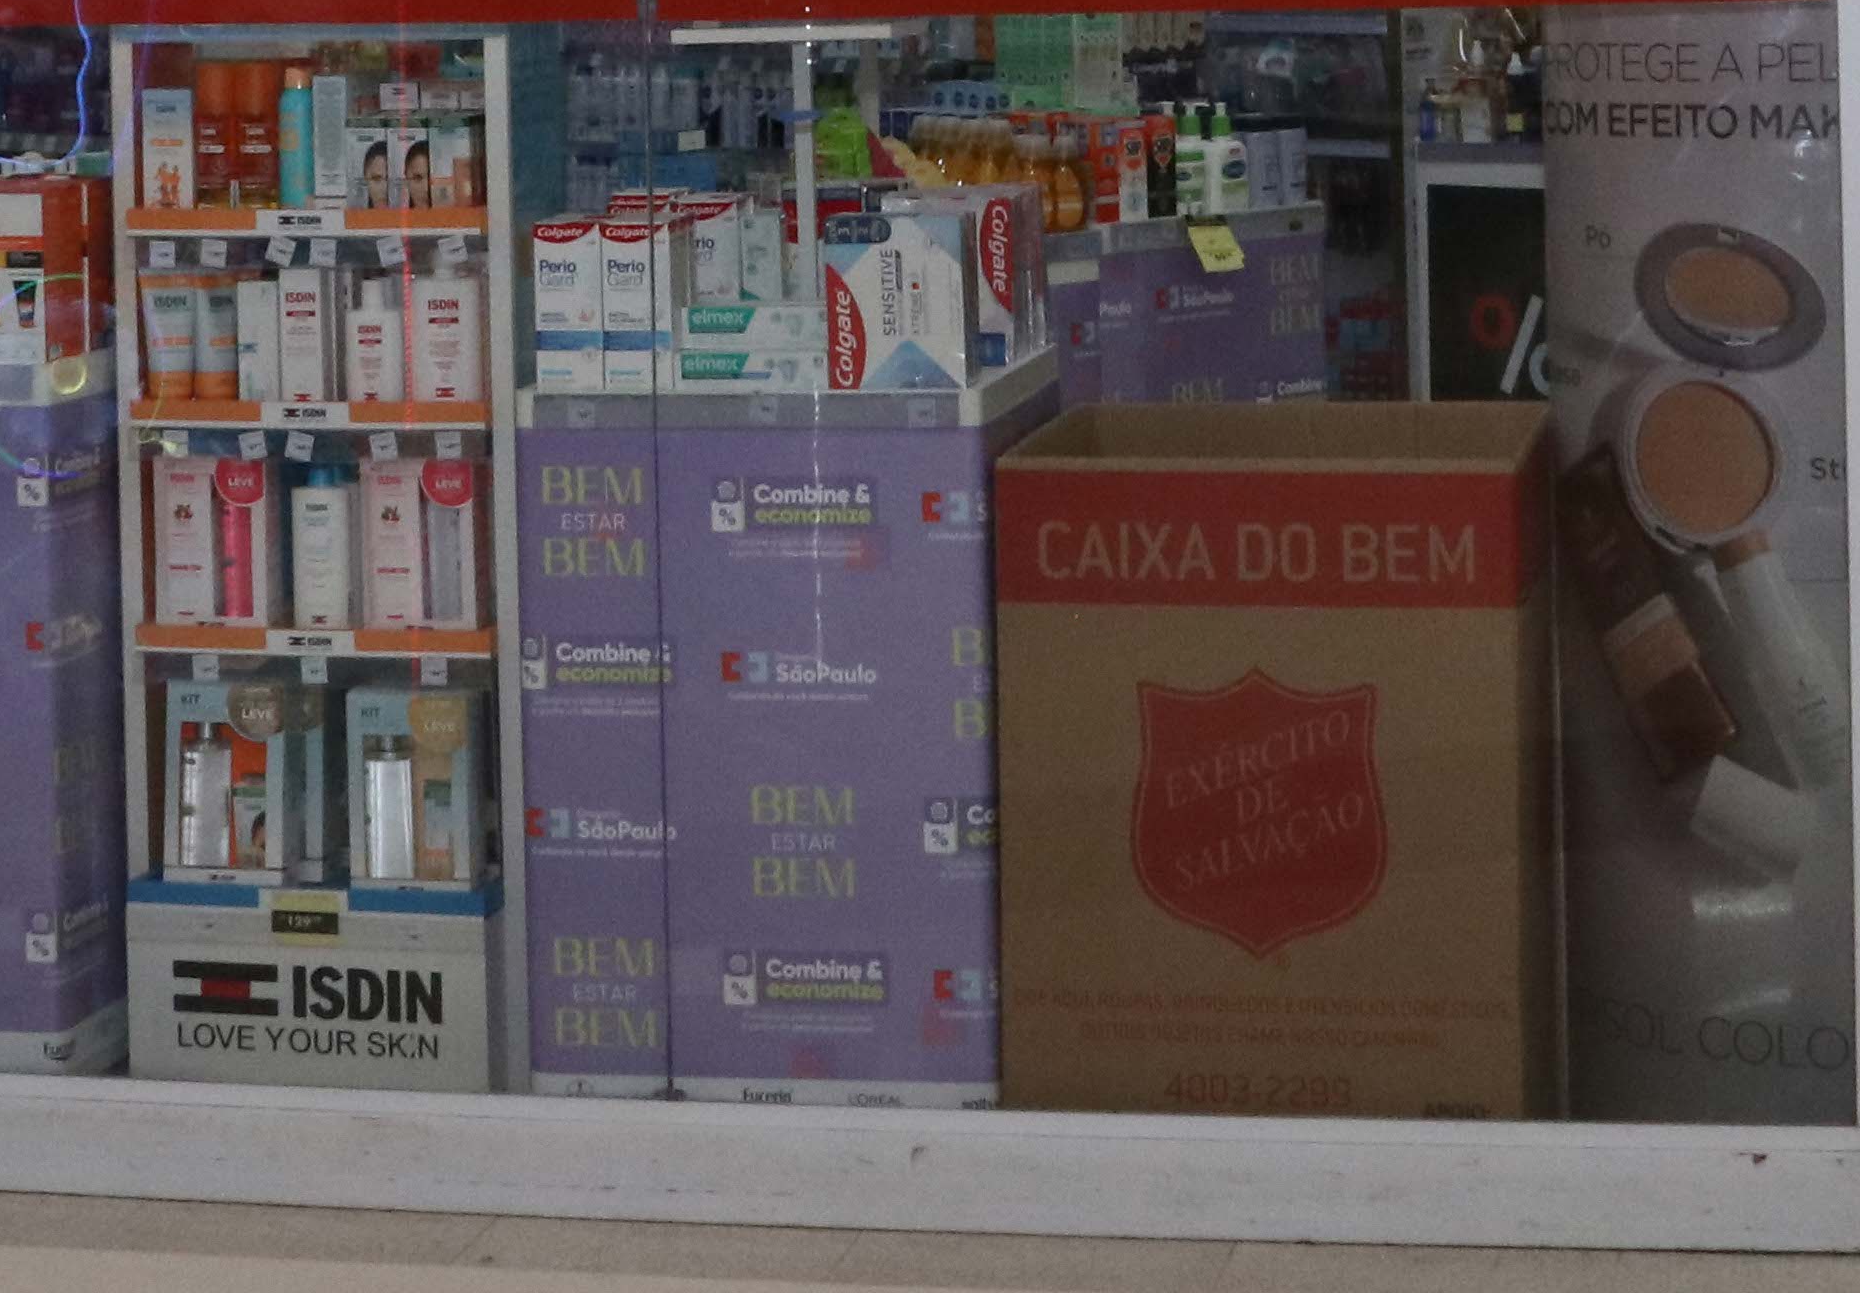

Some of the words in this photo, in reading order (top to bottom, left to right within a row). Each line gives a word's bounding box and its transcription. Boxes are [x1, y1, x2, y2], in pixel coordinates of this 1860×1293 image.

[1710, 42, 1744, 83] A
[1756, 41, 1839, 83] PEL
[1543, 103, 1599, 139] COM
[1608, 102, 1738, 140] EFEITO
[1749, 102, 1840, 140] MAK
[536, 225, 585, 240] Colgate
[605, 225, 653, 240] Colgate
[990, 203, 1011, 295] Colgate
[540, 259, 578, 276] Perio
[606, 259, 646, 276] Perio
[151, 294, 189, 310] ISDIN
[284, 290, 317, 305] ISDIN
[882, 247, 897, 337] SENSITIVE
[427, 298, 460, 311] ISDIN
[690, 309, 745, 328] elmex
[833, 288, 854, 389] Colgate
[683, 356, 739, 373] elmex
[226, 475, 255, 488] LEVE
[434, 477, 463, 491] LEVE
[541, 465, 644, 506] BEM
[752, 483, 849, 509] Combine
[854, 484, 871, 505] &
[560, 513, 627, 534] ESTAR
[753, 505, 873, 526] economize
[542, 537, 647, 578] BEM
[1037, 520, 1218, 582] CAIXA
[1237, 522, 1318, 583] DO
[1342, 523, 1478, 585] BEM
[555, 642, 651, 665] Combine
[555, 665, 674, 685] economize
[775, 661, 878, 686] SãoPaulo
[180, 694, 202, 706] KIT
[241, 707, 274, 721] LEVE
[1163, 709, 1353, 810] EXÉRCITO
[749, 785, 857, 825] BEM
[1235, 780, 1290, 825] DE
[576, 817, 678, 842] SãoPaulo
[770, 831, 838, 852] ESTAR
[1172, 790, 1365, 893] SALVAÇÃO
[751, 857, 857, 899] BEM
[552, 937, 655, 978] BEM
[764, 958, 862, 982] Combine
[866, 960, 883, 981] &
[291, 964, 445, 1024] ISDIN
[571, 983, 638, 1003] ESTAR
[765, 979, 885, 1002] economize
[553, 1006, 659, 1049] BEM
[176, 1022, 256, 1052] LOVE
[265, 1026, 357, 1057] YOUR
[367, 1031, 440, 1061] SKIN
[1696, 1015, 1851, 1071] COLO
